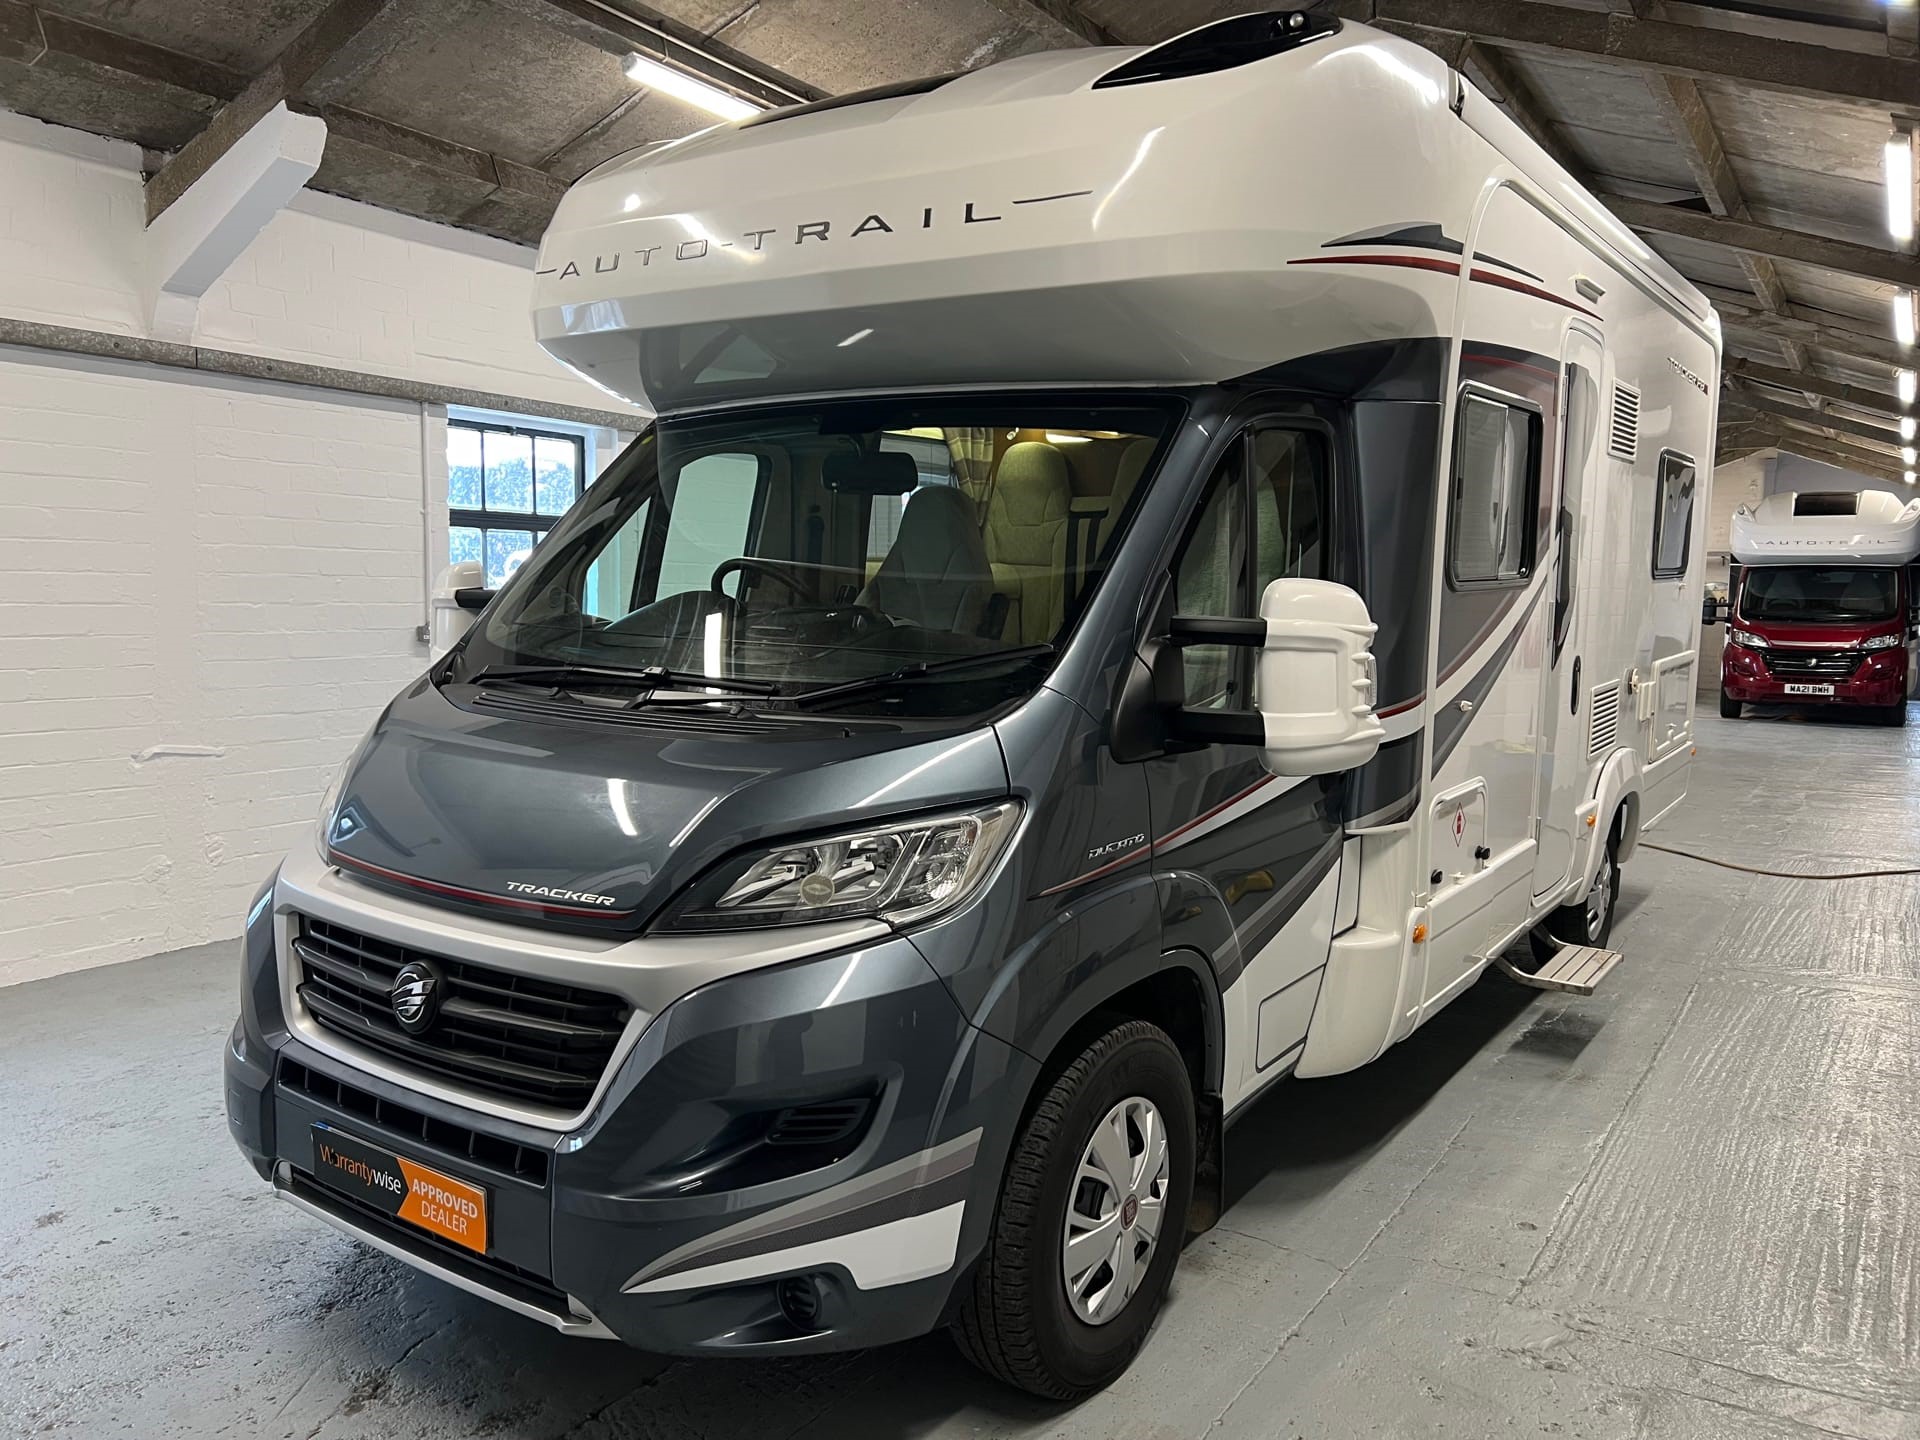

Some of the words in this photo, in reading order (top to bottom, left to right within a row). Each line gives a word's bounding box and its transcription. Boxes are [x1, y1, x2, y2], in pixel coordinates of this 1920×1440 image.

[559, 202, 1002, 280] AUTO-TRAIL
[1088, 833, 1145, 860] DUCATO
[507, 881, 616, 906] TRACKER
[320, 1143, 402, 1195] Warrantywise
[412, 1179, 478, 1219] APPROVED
[421, 1201, 468, 1235] DEALER
